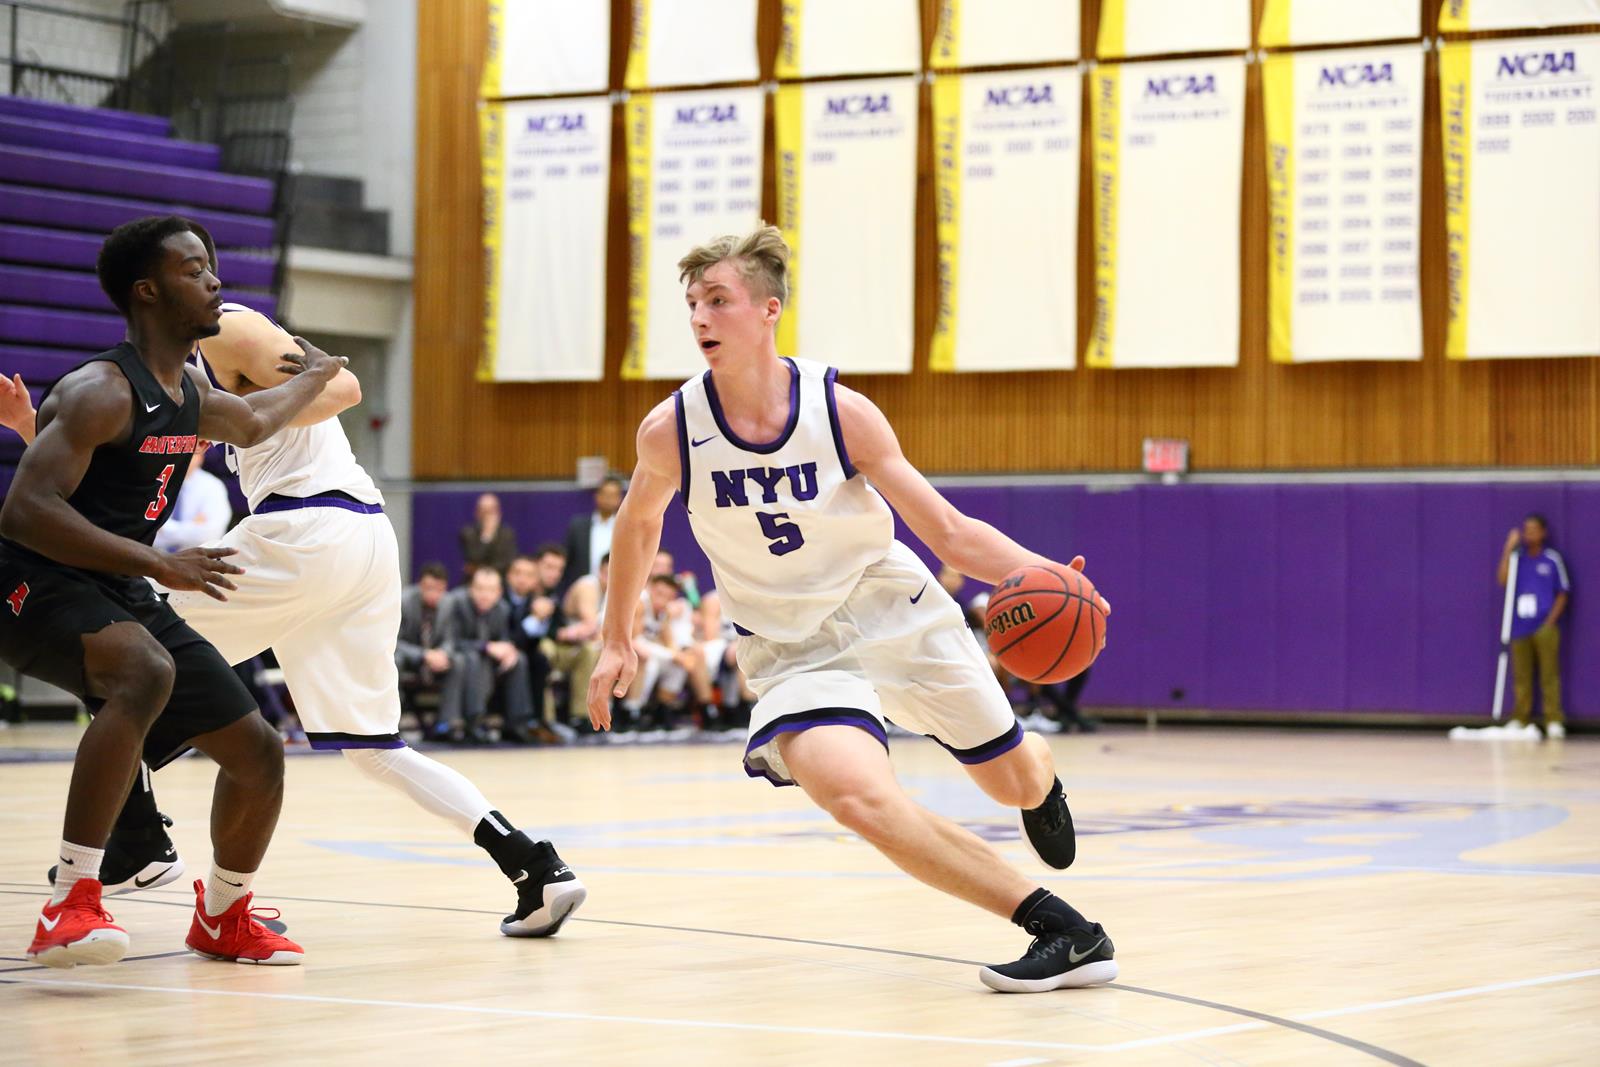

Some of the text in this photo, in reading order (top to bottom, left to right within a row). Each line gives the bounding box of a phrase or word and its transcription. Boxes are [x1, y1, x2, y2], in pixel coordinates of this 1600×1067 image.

[1318, 62, 1393, 89] NCAA
[1497, 51, 1576, 79] NCAA
[985, 83, 1054, 109] NCAA
[1144, 73, 1216, 101] NCAA
[825, 93, 891, 117] NCAA
[139, 434, 197, 454] HAVERF
[145, 464, 175, 521] 3
[711, 461, 819, 508] NYU
[755, 511, 805, 557] 5
